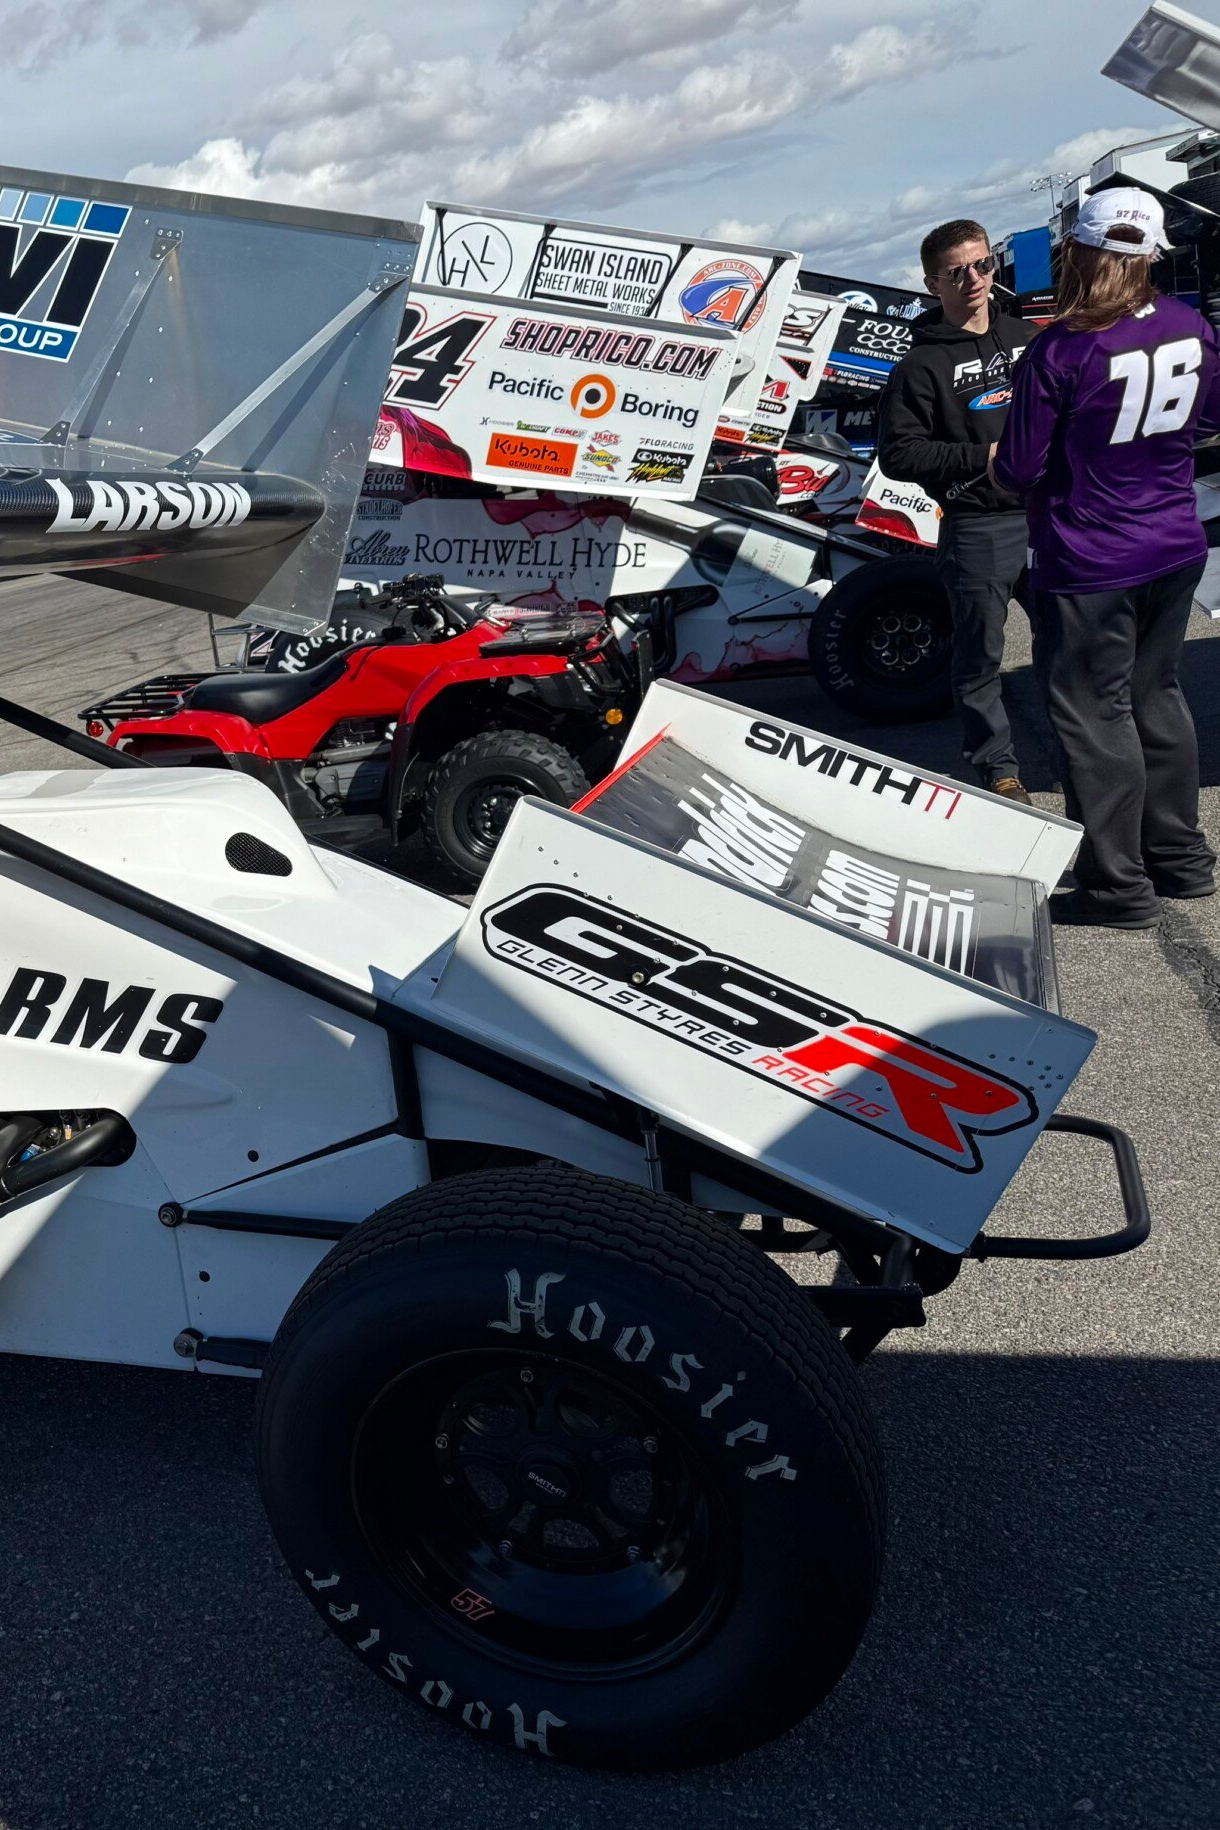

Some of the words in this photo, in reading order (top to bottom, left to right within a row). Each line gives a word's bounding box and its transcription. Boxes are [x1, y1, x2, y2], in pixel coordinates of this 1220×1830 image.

[542, 244, 596, 276] SWAN
[597, 252, 664, 285] ISLAND
[537, 271, 571, 293] SHEET
[572, 278, 608, 298] METAL
[609, 284, 656, 306] WORKS
[609, 301, 632, 315] SINCE
[500, 318, 723, 382] SHOPRICO.COM
[849, 346, 903, 362] CONSTRUCTIO
[488, 371, 564, 401] Pacific
[620, 393, 699, 428] Boring
[495, 437, 559, 462] Kubota
[644, 438, 695, 451] FLORACING
[652, 453, 687, 466] Kubota
[364, 471, 407, 485] CURB
[509, 460, 542, 471] GENUINE
[544, 465, 569, 475] PARTS
[45, 477, 252, 534] LARSON
[880, 488, 934, 514] Pacific
[414, 533, 563, 566] ROTHWELL
[570, 537, 647, 569] HYDE
[467, 568, 506, 579] NAPA
[516, 569, 576, 581] VALLEY
[278, 618, 377, 674] Hoosier
[491, 890, 1020, 1153] GSR
[496, 940, 609, 991] GLENN
[609, 984, 756, 1056] STYRES
[751, 1055, 891, 1119] RACING
[487, 1267, 798, 1481] Hoosier
[451, 1588, 494, 1622] 57
[305, 1568, 567, 1758] Hoosier
